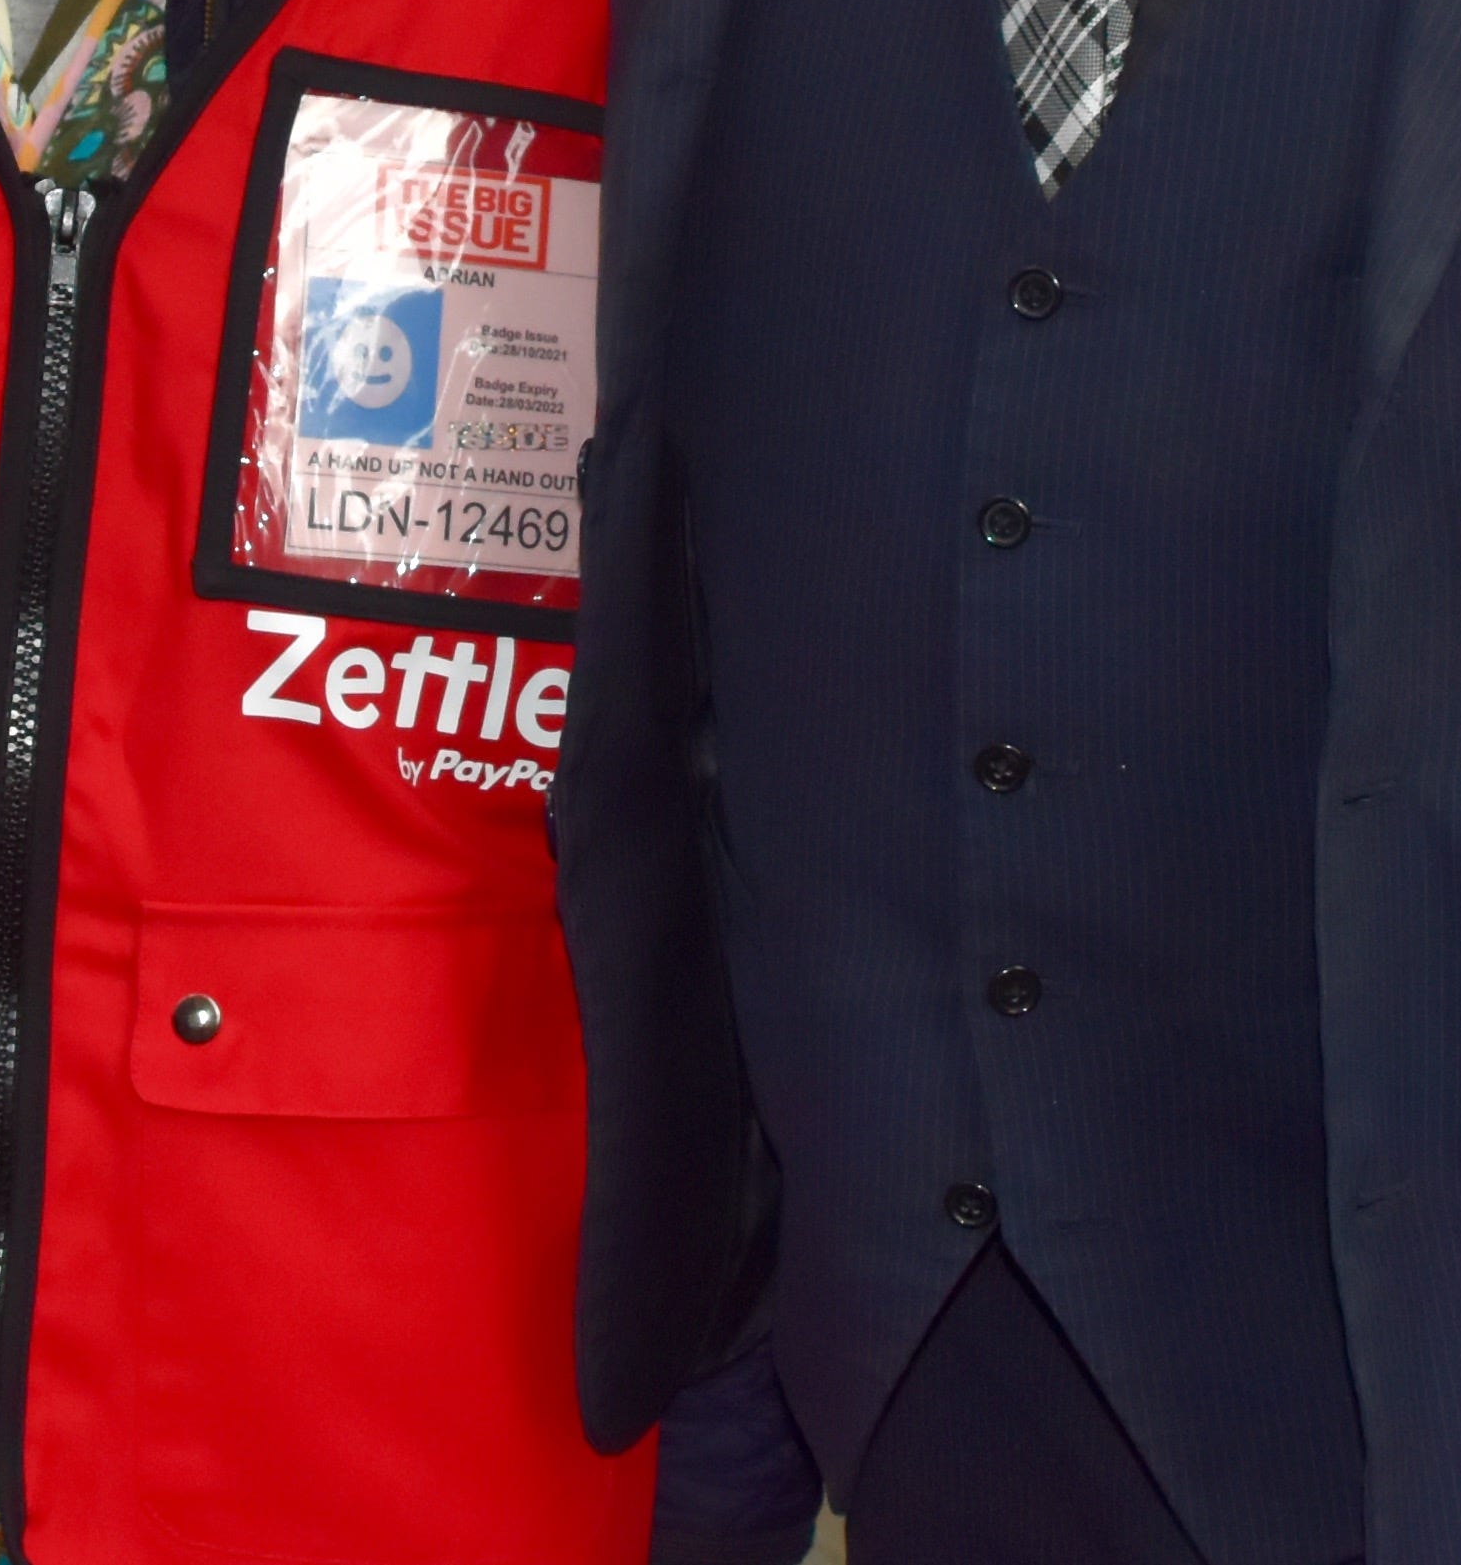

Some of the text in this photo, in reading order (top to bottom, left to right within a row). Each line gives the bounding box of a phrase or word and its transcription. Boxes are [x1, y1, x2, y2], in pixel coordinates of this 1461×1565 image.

[474, 186, 532, 217] BIG
[396, 208, 531, 253] SSUE
[424, 265, 495, 289] ADRIAN
[481, 324, 559, 344] Badge Issue
[474, 376, 558, 399] Badge Expiry
[307, 451, 577, 492] A HAND UP NOT A HAND OUT
[307, 488, 569, 551] LDN-12469
[242, 609, 571, 748] Zettle
[398, 747, 555, 790] by PayPa
